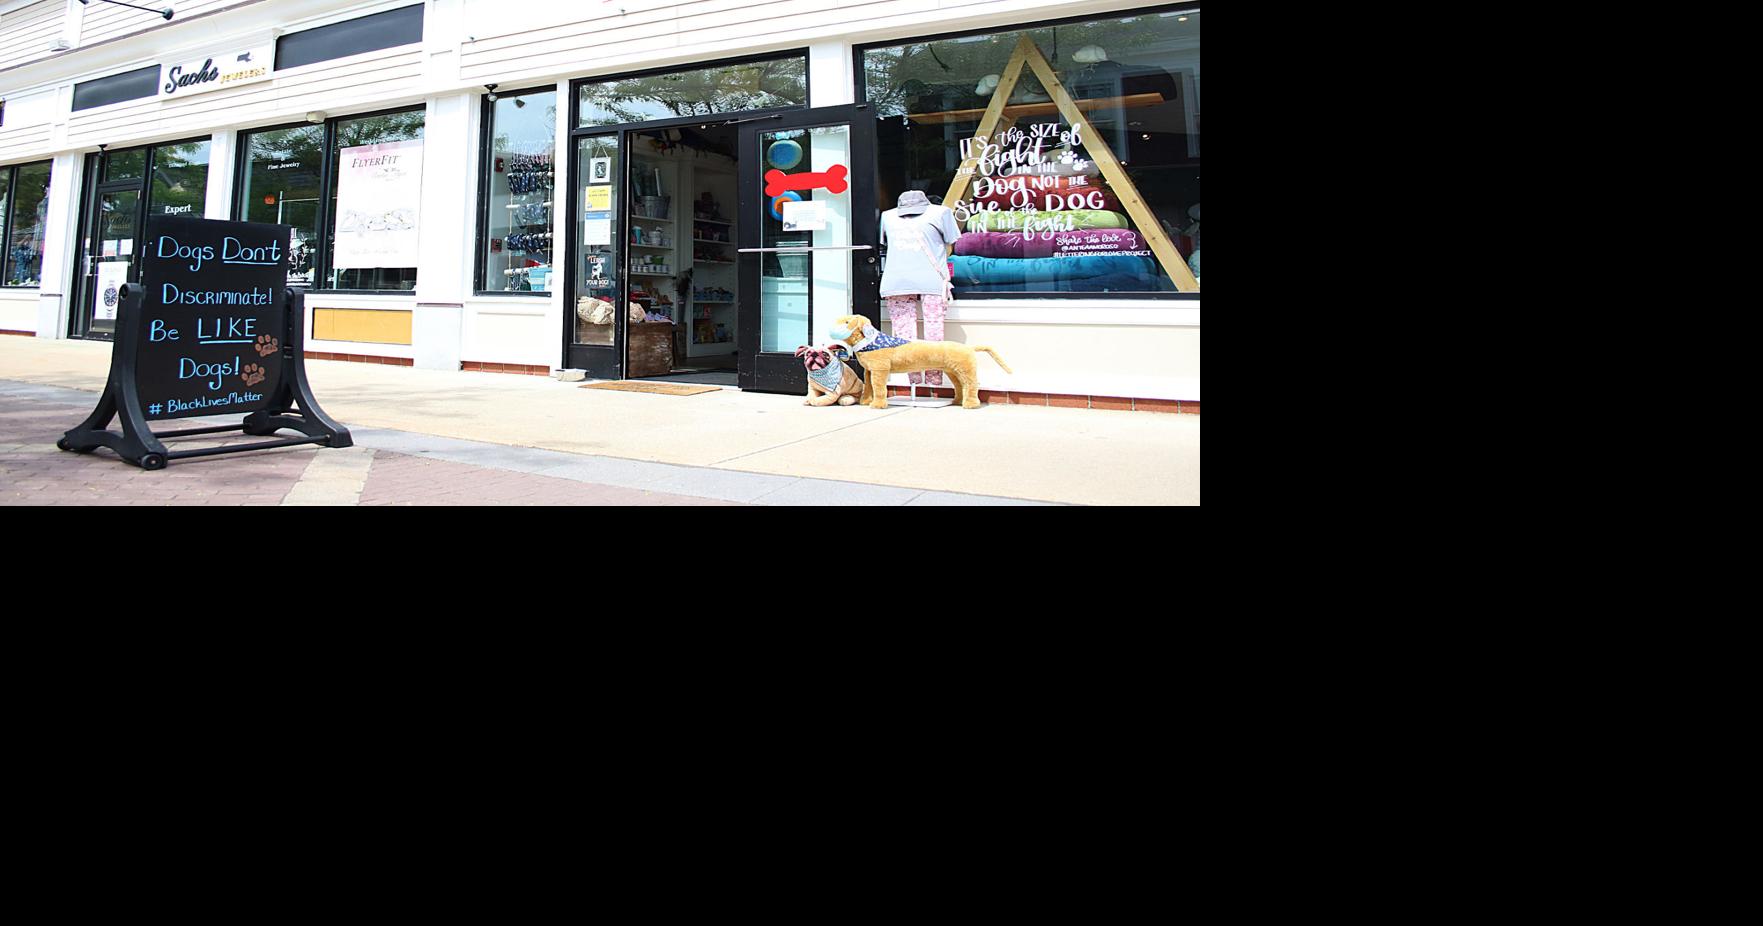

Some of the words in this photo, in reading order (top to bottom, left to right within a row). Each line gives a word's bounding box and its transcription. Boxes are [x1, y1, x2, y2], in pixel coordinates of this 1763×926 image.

[165, 58, 219, 94] Sachs
[220, 67, 266, 84] JEWELERS
[1030, 122, 1061, 138] SIZE
[1060, 122, 1082, 147] of
[978, 136, 1047, 177] fight
[1037, 161, 1058, 173] THE
[1032, 174, 1060, 191] NOT
[1068, 174, 1089, 186] THE
[165, 204, 192, 215] Expert
[1046, 190, 1105, 212] DOG
[971, 221, 988, 233] IN
[158, 236, 215, 271] Dogs
[222, 236, 281, 261] Don't
[150, 319, 180, 341] Be
[198, 317, 257, 339] LIKE
[179, 356, 240, 390] Dogs!
